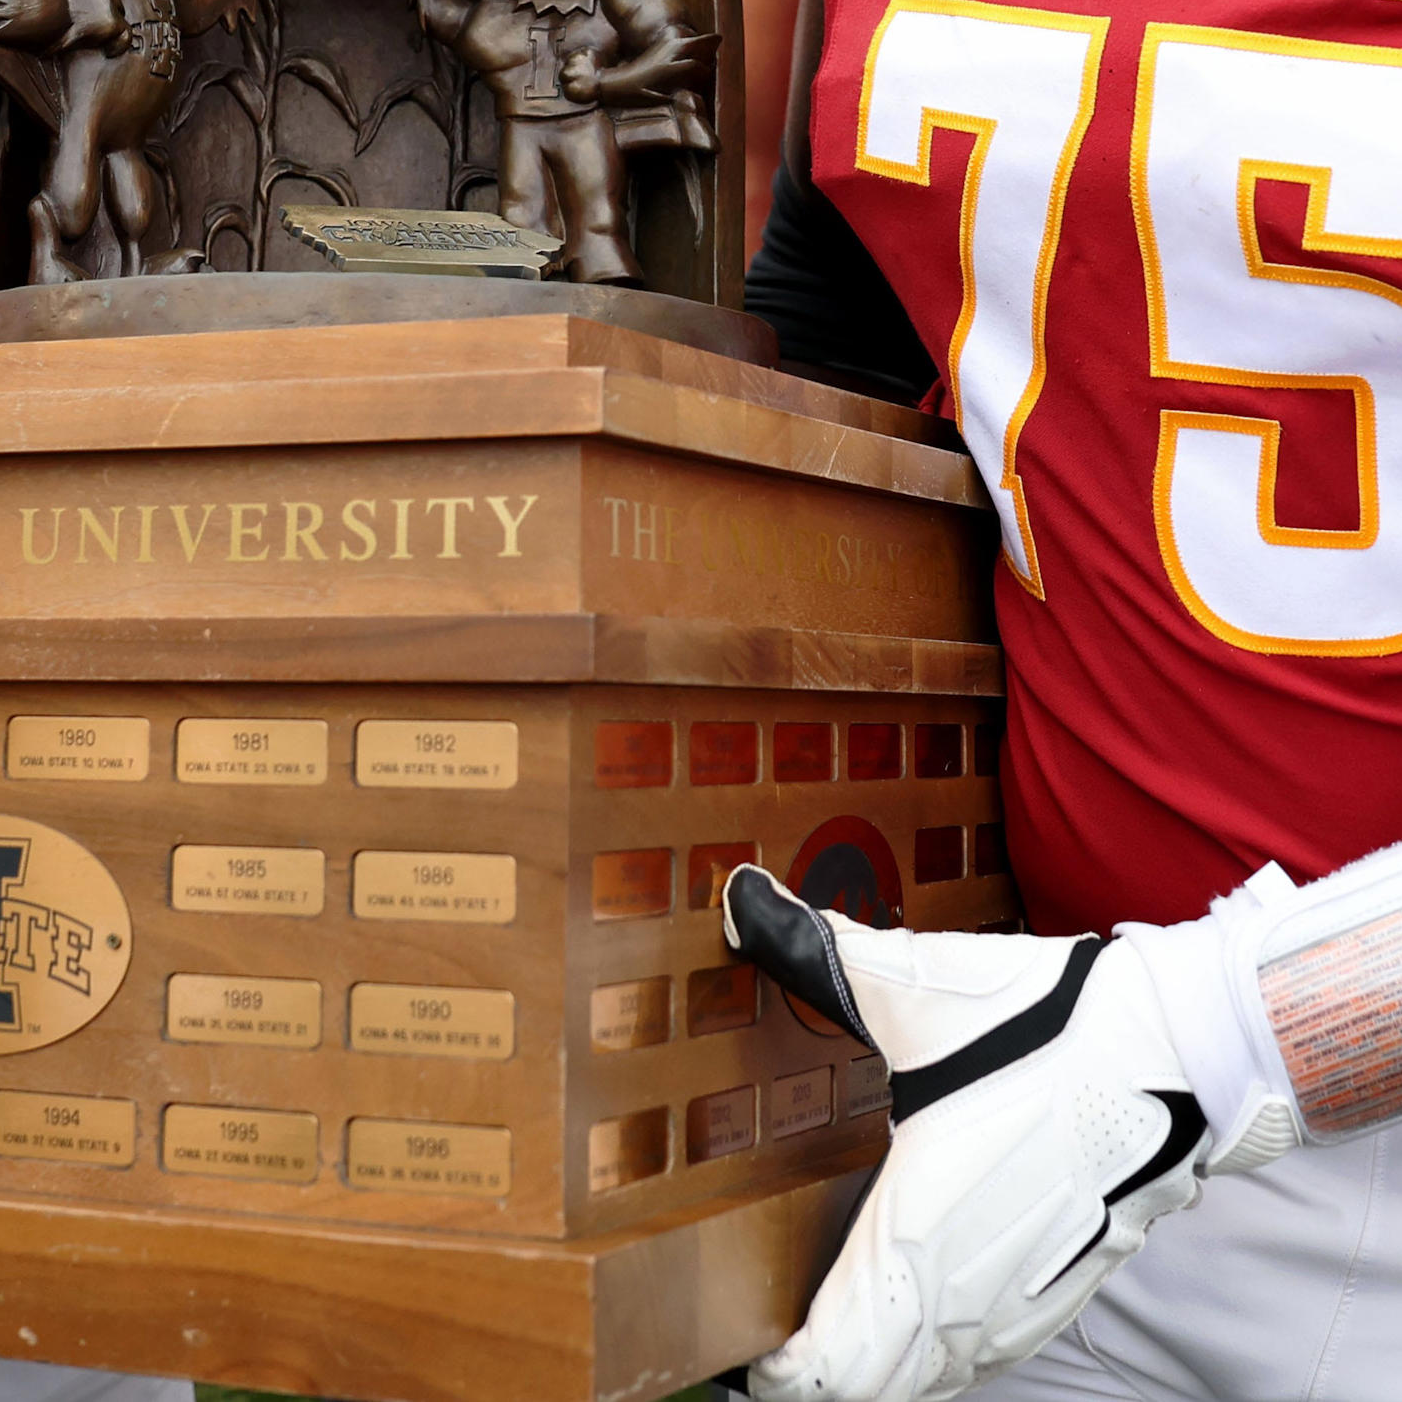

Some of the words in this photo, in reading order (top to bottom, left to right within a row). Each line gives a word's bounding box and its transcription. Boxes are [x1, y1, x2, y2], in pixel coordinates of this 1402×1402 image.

[19, 493, 540, 564] UNIVERSITY
[59, 729, 95, 746] 1980
[233, 733, 269, 751] 1981
[415, 734, 455, 753] 1982
[20, 757, 44, 766] IOWA
[49, 757, 77, 767] STATE
[98, 758, 123, 768] IOWA
[186, 762, 211, 773] IOWA
[216, 762, 248, 773] STATE
[273, 764, 300, 773] IOWA
[228, 860, 266, 878] 1985
[413, 867, 454, 885] 1986
[224, 990, 262, 1010] 1989
[410, 1000, 451, 1020] 1990
[44, 1107, 80, 1125] 1994
[221, 1121, 259, 1141] 1995
[3, 1132, 28, 1144] IOWA
[49, 1136, 74, 1148] IOWA
[79, 1138, 108, 1151] STATE
[407, 1137, 449, 1158] 1996
